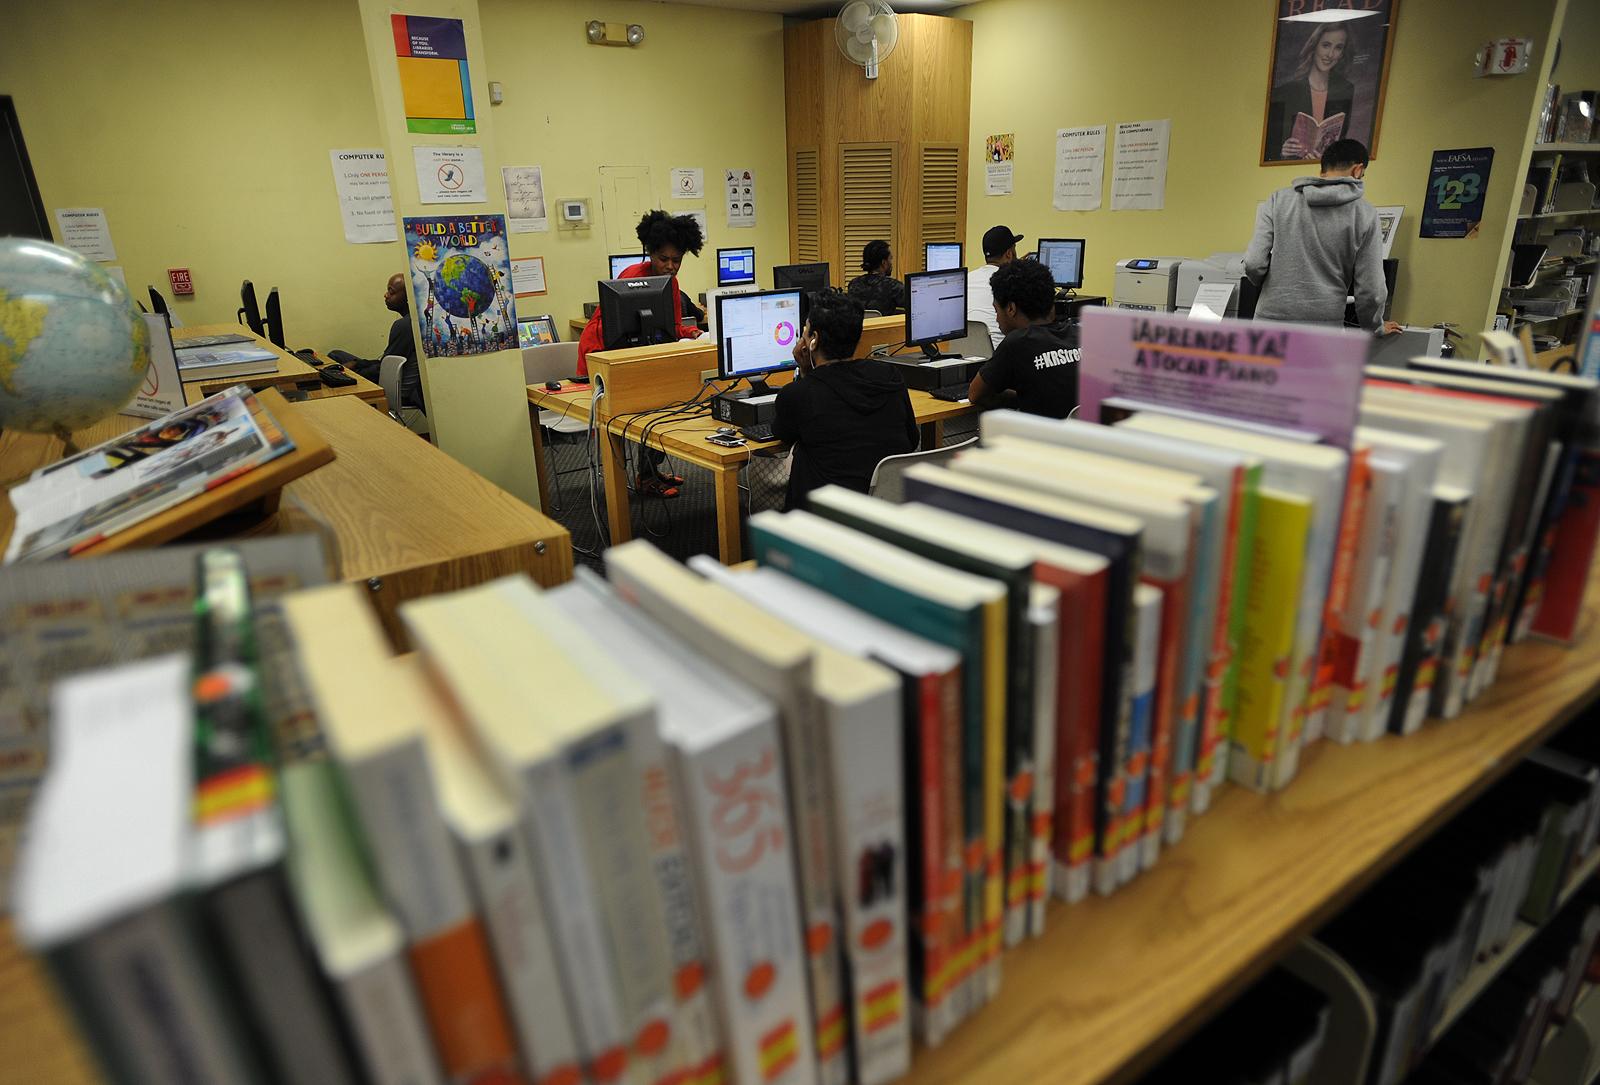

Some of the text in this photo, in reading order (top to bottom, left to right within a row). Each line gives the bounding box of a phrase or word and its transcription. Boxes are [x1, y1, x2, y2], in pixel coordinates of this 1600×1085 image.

[1448, 154, 1472, 162] FAFSA
[1433, 173, 1481, 210] 123
[415, 221, 497, 236] BUILD A BETTER
[440, 234, 478, 248] WORLD
[171, 272, 190, 282] FIRE
[1135, 351, 1148, 369] A
[1151, 352, 1207, 376] TOCAR
[704, 749, 784, 874] 365
